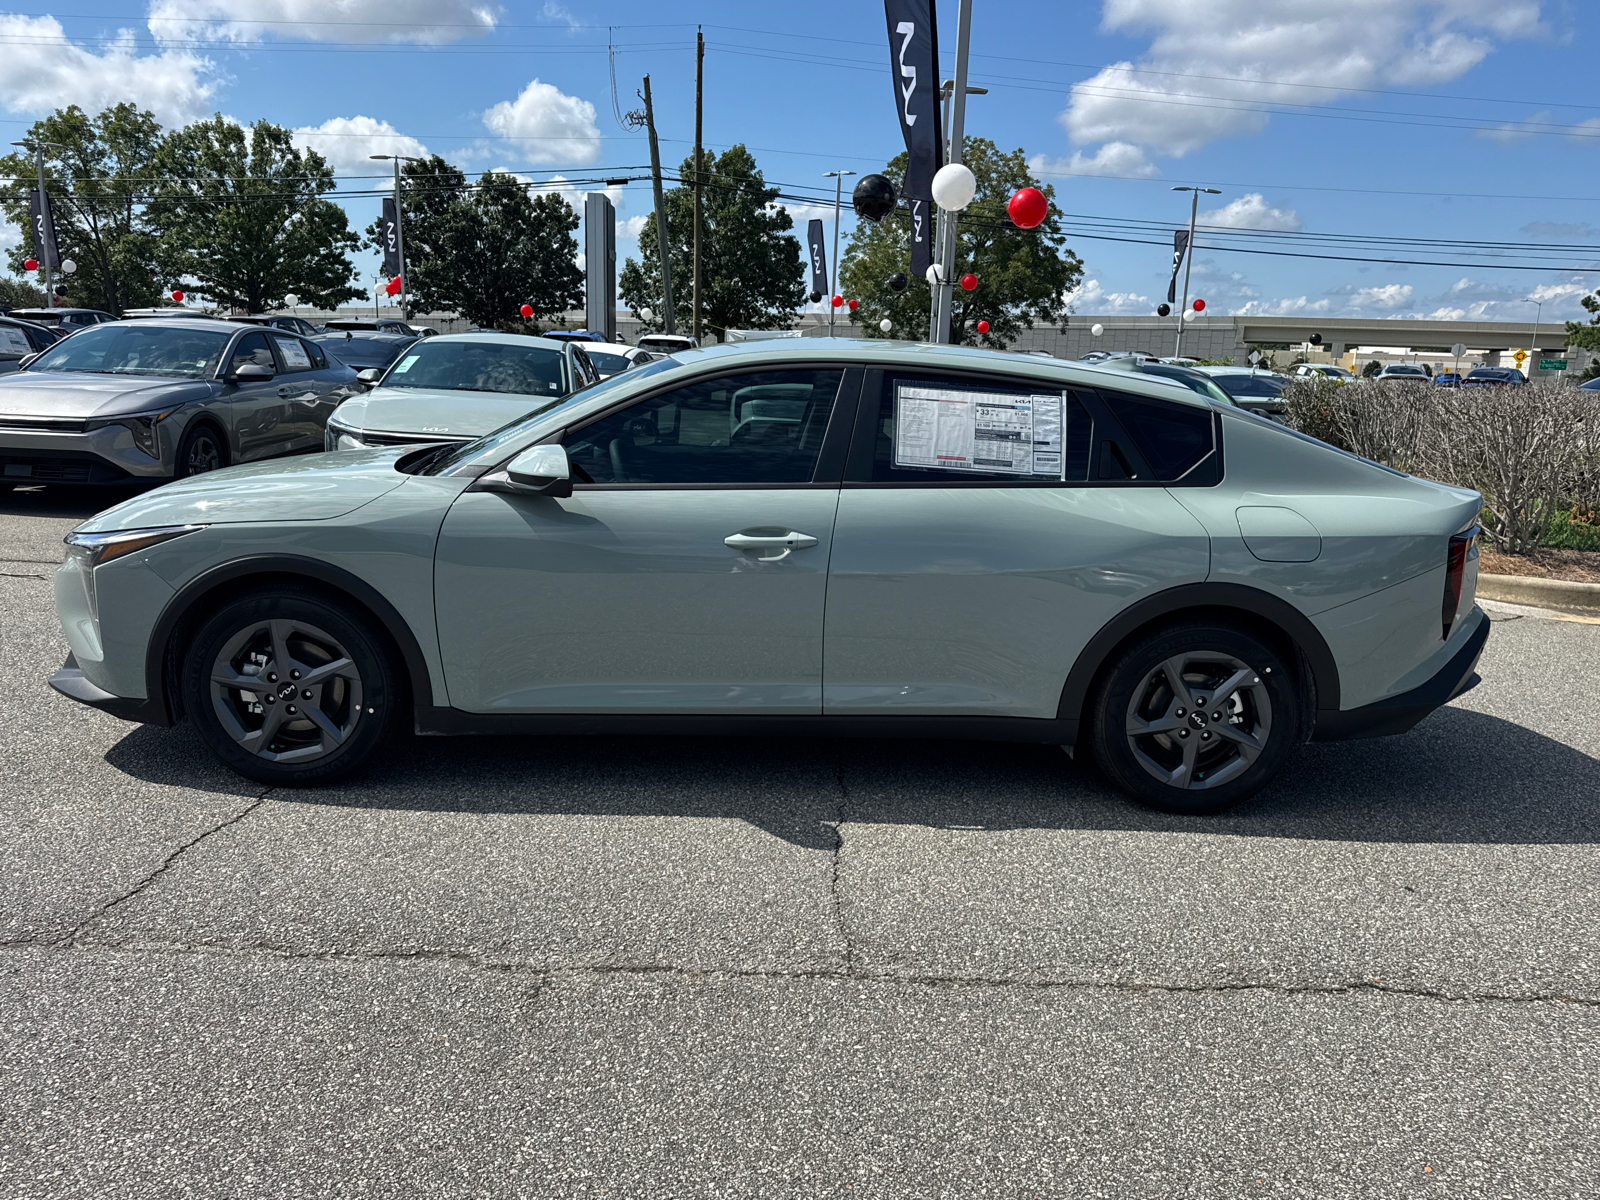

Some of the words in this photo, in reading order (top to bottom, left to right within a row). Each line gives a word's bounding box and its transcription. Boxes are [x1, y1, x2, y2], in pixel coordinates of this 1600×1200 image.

[980, 408, 990, 416] 33
[191, 645, 207, 704] SOLUS
[278, 684, 296, 700] KIA
[1191, 712, 1206, 729] KIA
